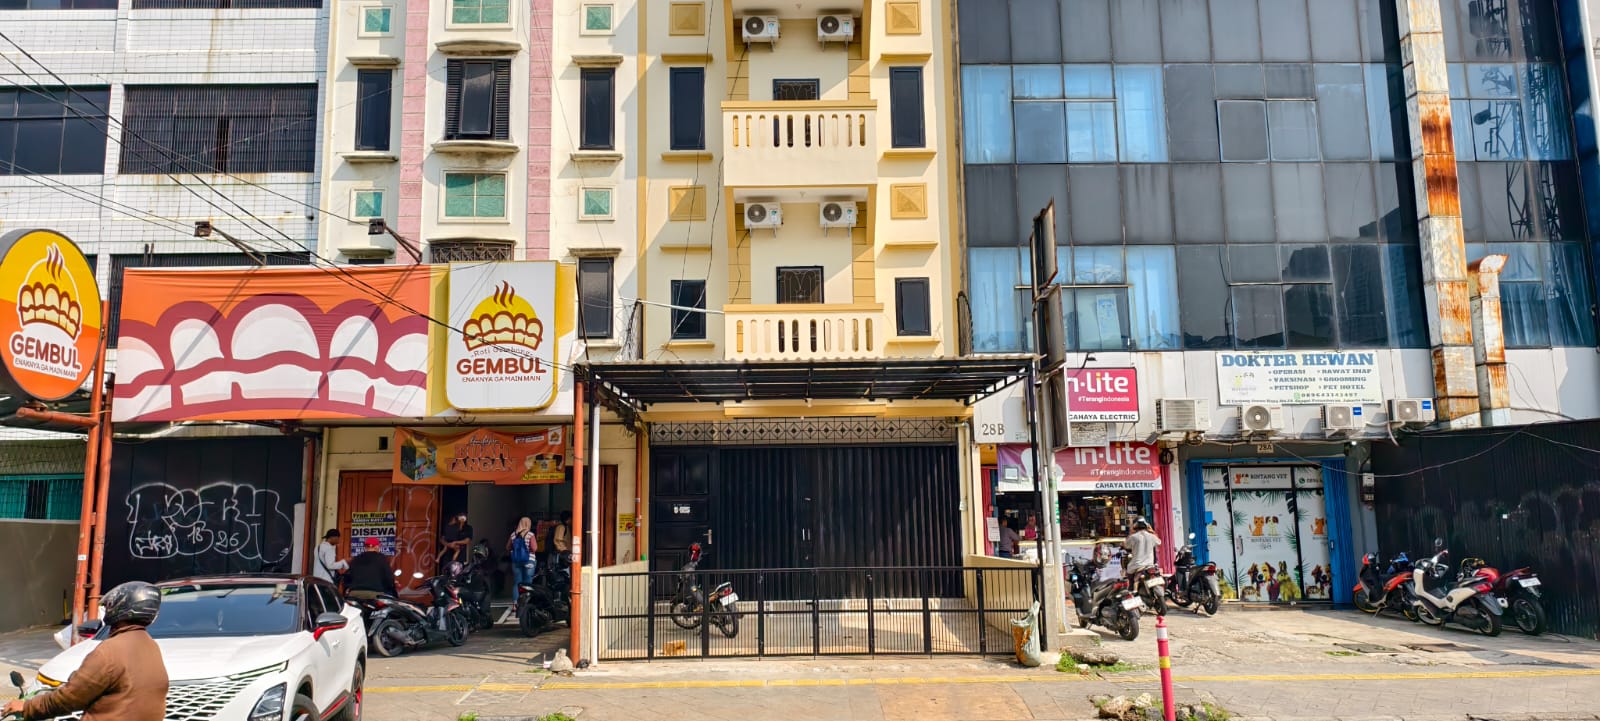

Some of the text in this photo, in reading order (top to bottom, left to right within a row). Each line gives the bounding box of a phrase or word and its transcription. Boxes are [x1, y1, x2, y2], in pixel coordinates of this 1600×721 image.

[11, 334, 81, 370] GEMBUL
[15, 358, 40, 369] ENAKNYA
[456, 358, 546, 374] GEMBUL
[1222, 353, 1374, 367] DOKTER HEWAN
[981, 423, 1005, 436] 28B
[455, 443, 511, 459] BUAH
[445, 457, 518, 473] TANGAN
[352, 527, 395, 536] DISEWA
